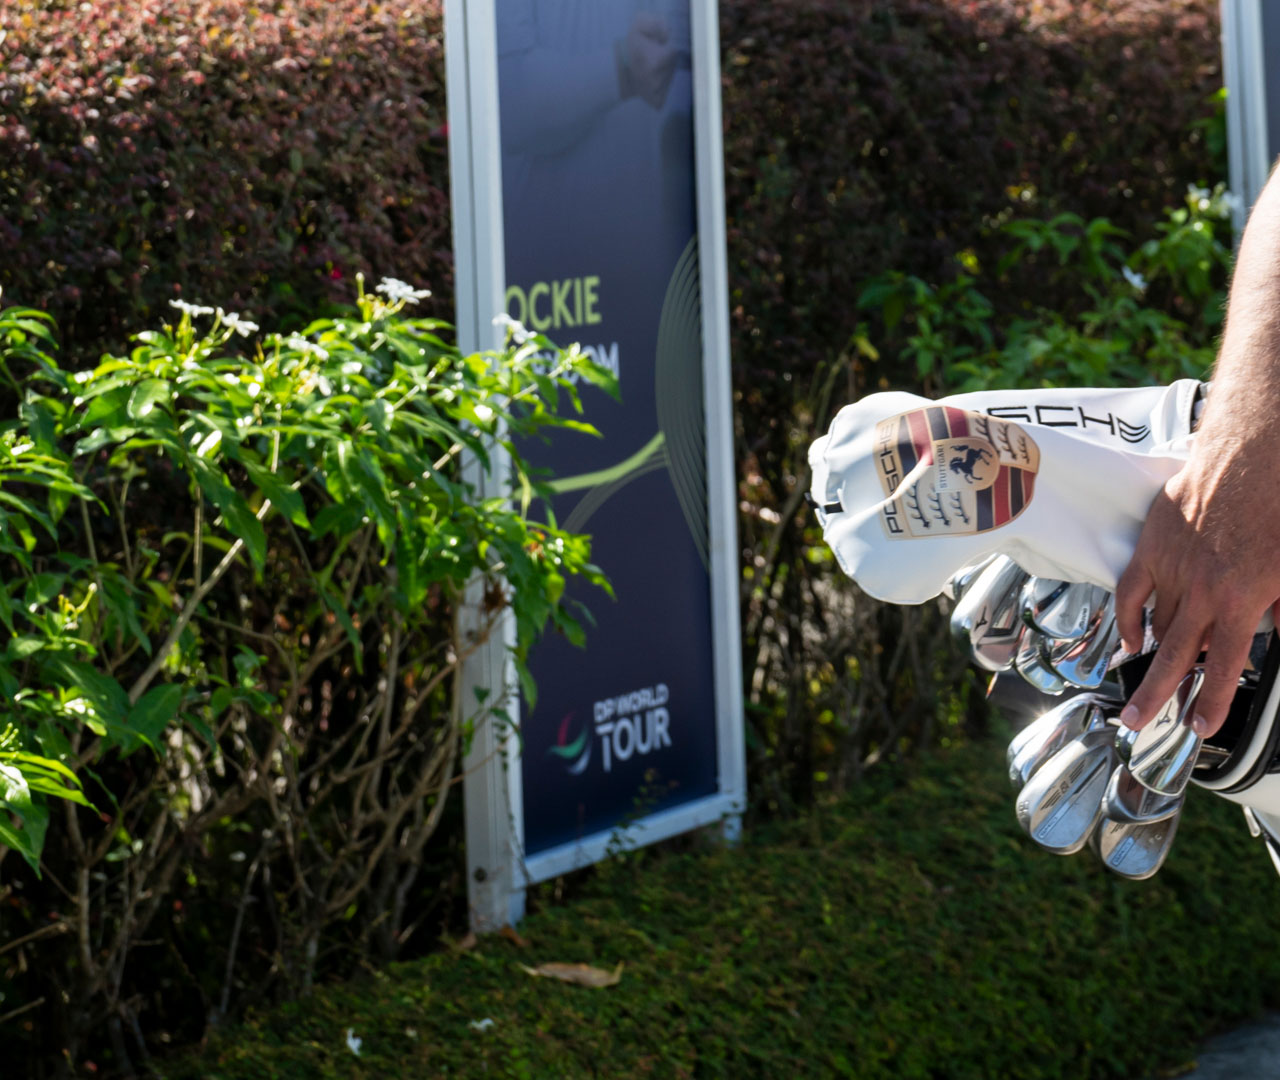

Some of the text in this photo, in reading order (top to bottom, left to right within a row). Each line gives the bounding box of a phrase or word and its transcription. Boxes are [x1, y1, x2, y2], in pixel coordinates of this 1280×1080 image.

[505, 275, 602, 332] OCKIE
[972, 405, 1151, 443] SCHE
[879, 422, 904, 533] POSCHE
[616, 682, 669, 716] WORLD
[595, 706, 672, 773] TOUR
